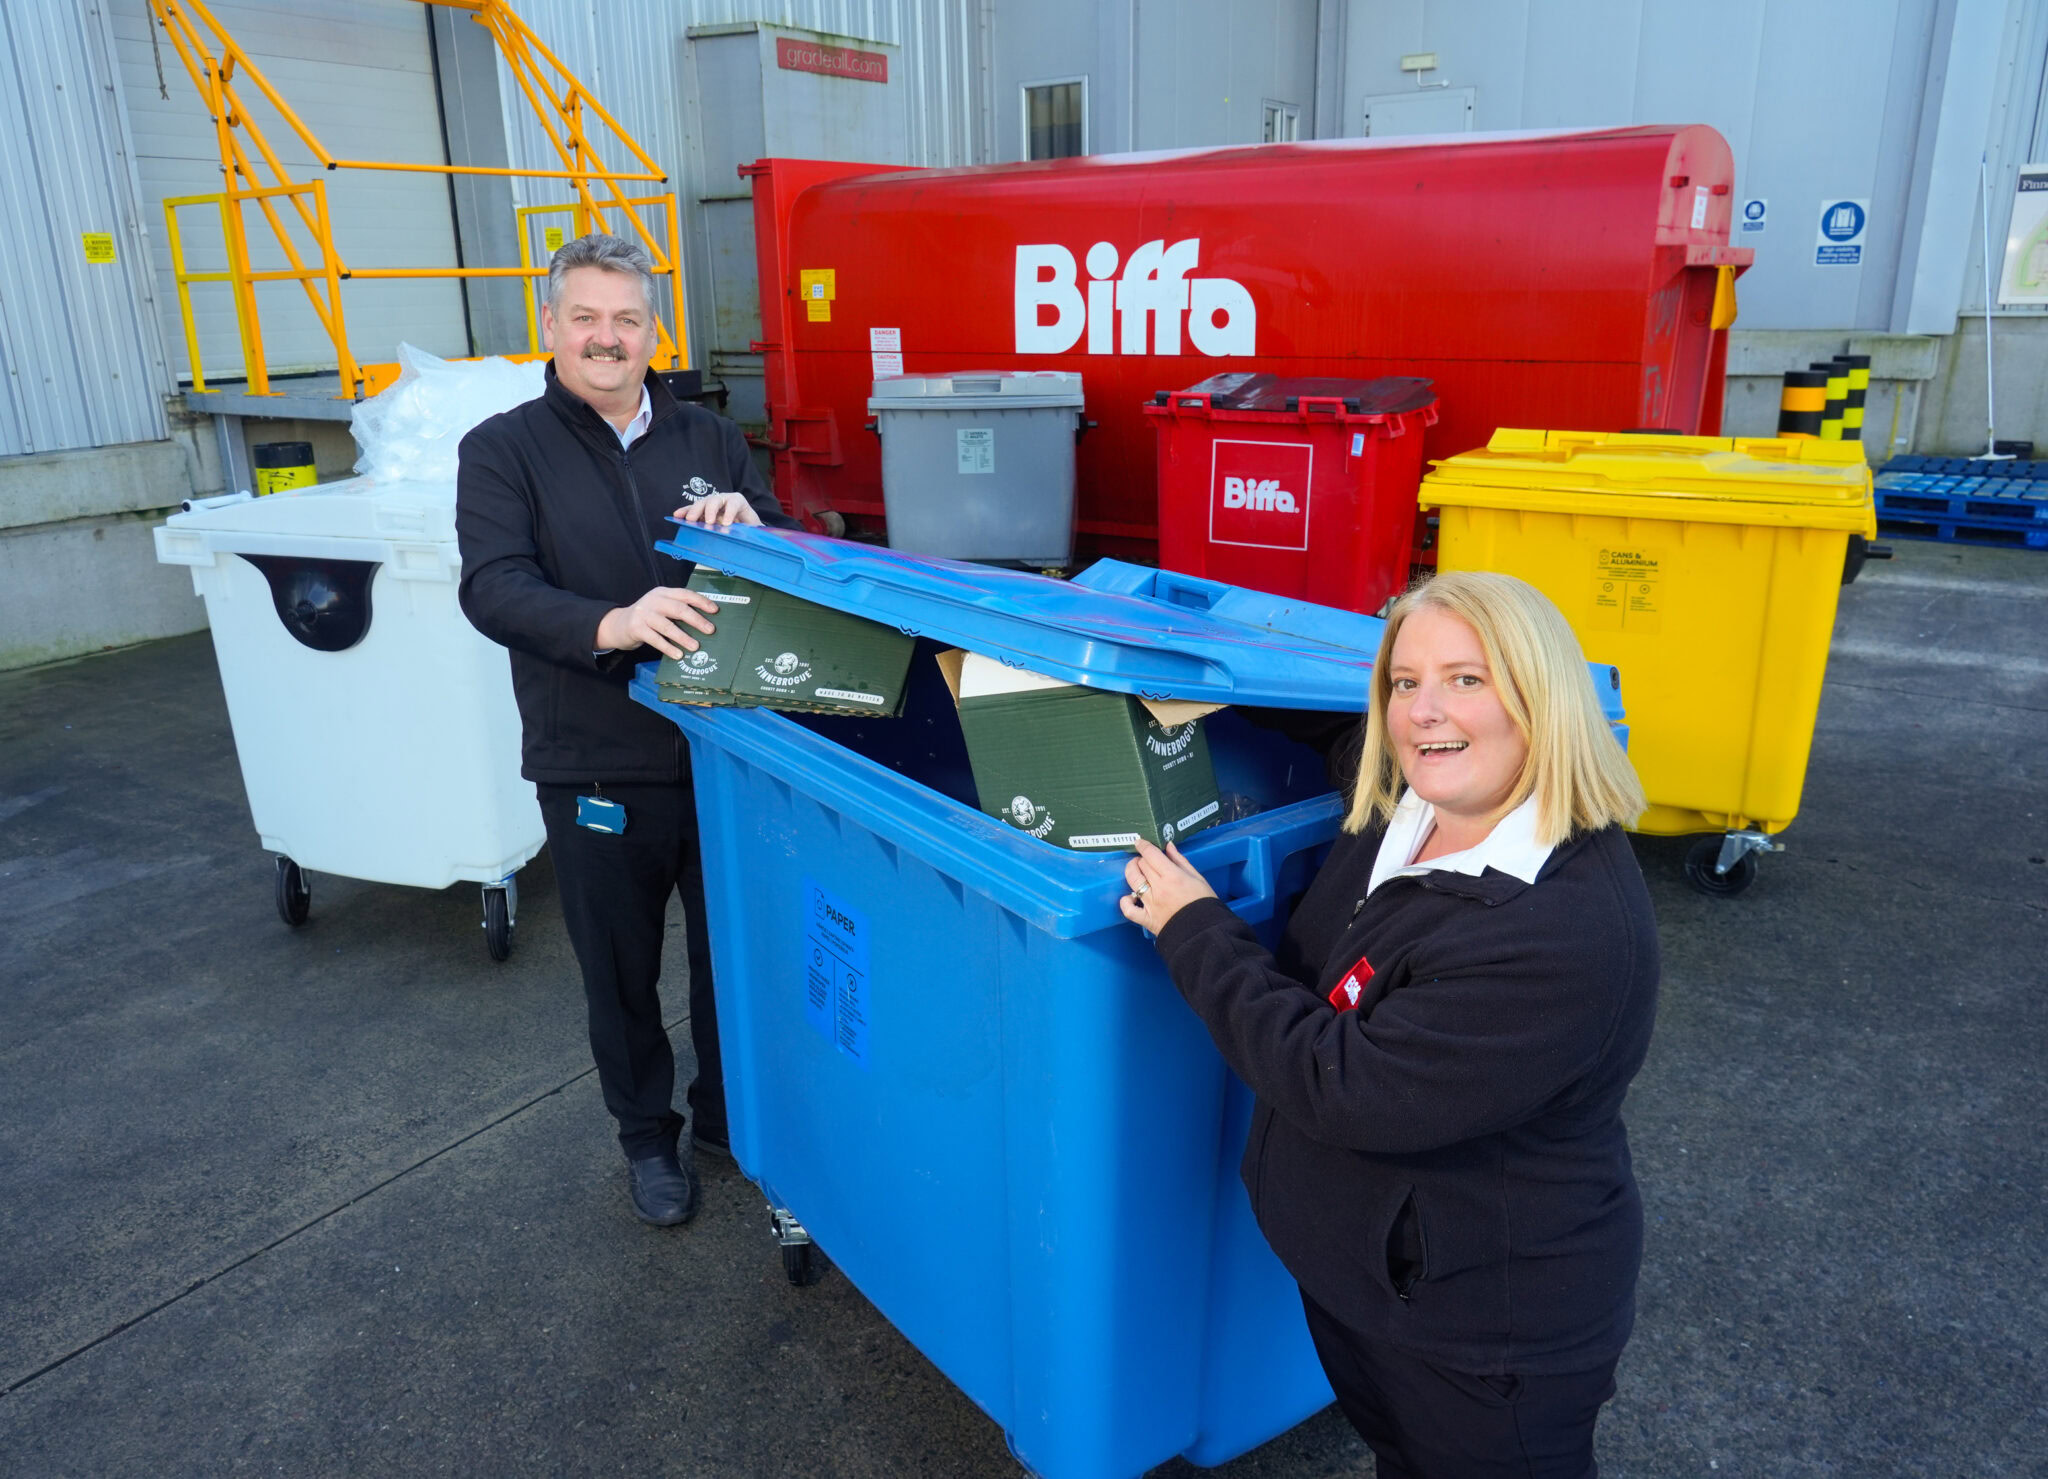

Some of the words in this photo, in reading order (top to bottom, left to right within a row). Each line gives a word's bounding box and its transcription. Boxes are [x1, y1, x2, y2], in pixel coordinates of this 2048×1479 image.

[786, 48, 883, 75] gradeall.com
[1015, 238, 1256, 357] Biffa
[1224, 477, 1298, 513] Biffa
[1611, 559, 1659, 567] ALUMINIUM
[677, 659, 718, 675] FINNEBROGUE
[754, 665, 813, 686] FINNEBROGUE
[857, 694, 880, 702] BETTER
[1146, 719, 1197, 757] FINNEBROGUE
[1179, 818, 1191, 827] MADE
[826, 904, 857, 937] PAPER
